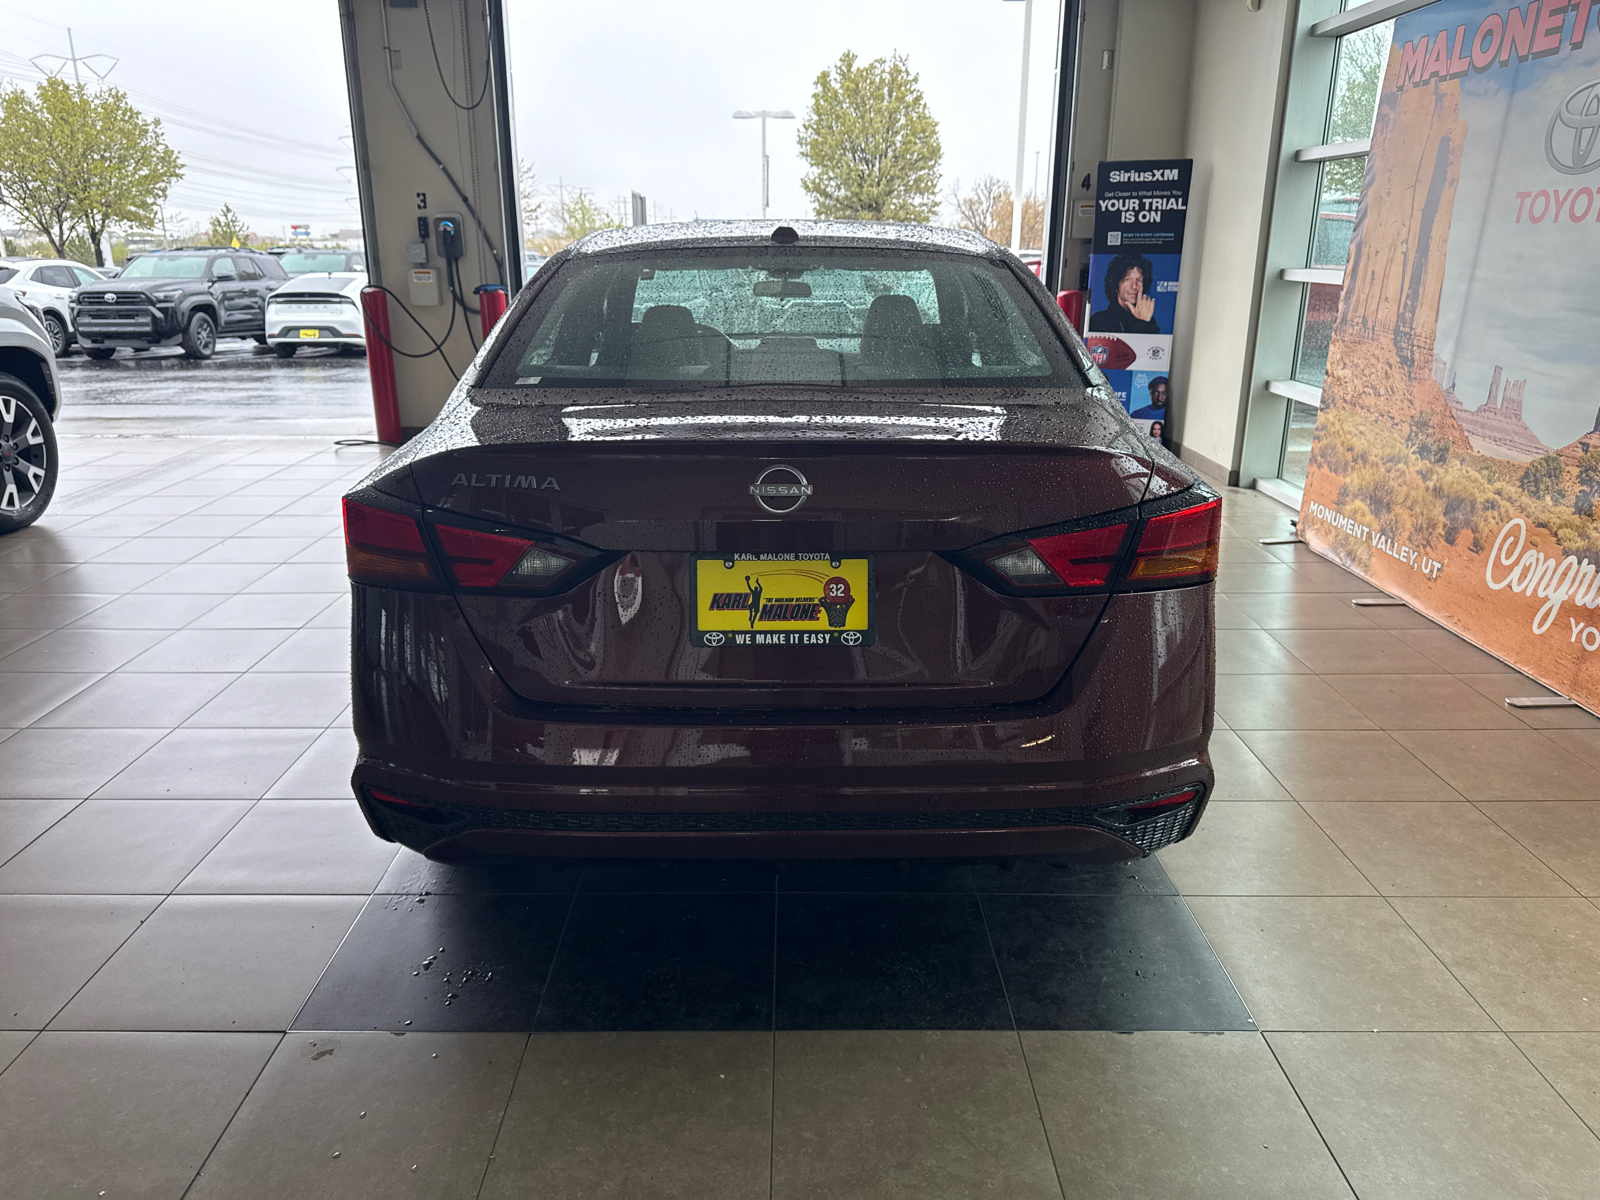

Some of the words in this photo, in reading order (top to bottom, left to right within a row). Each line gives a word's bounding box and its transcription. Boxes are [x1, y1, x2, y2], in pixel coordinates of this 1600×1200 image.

[1396, 0, 1600, 92] MALONET
[1081, 173, 1091, 191] 4
[1109, 169, 1178, 182] SiriusXM
[416, 192, 427, 210] 3
[1099, 199, 1139, 211] YOUR
[1143, 198, 1186, 210] TRIAL
[1121, 211, 1135, 223] IS
[1138, 211, 1161, 223] ON
[451, 472, 561, 491] ALTIMA
[750, 486, 812, 494] NISSAN
[1309, 500, 1370, 542] MONUMENT
[1371, 530, 1419, 572] VALLEY,
[1421, 560, 1442, 579] UT
[734, 553, 757, 561] KARL
[760, 553, 795, 561] MALONE
[798, 553, 830, 561] TOYOTA
[829, 584, 845, 597] 32
[709, 592, 751, 611] KARL
[758, 603, 822, 621] MALONE
[735, 633, 752, 644] WE
[756, 633, 785, 644] MAKE
[790, 633, 799, 643] IT
[803, 633, 831, 644] EASY
